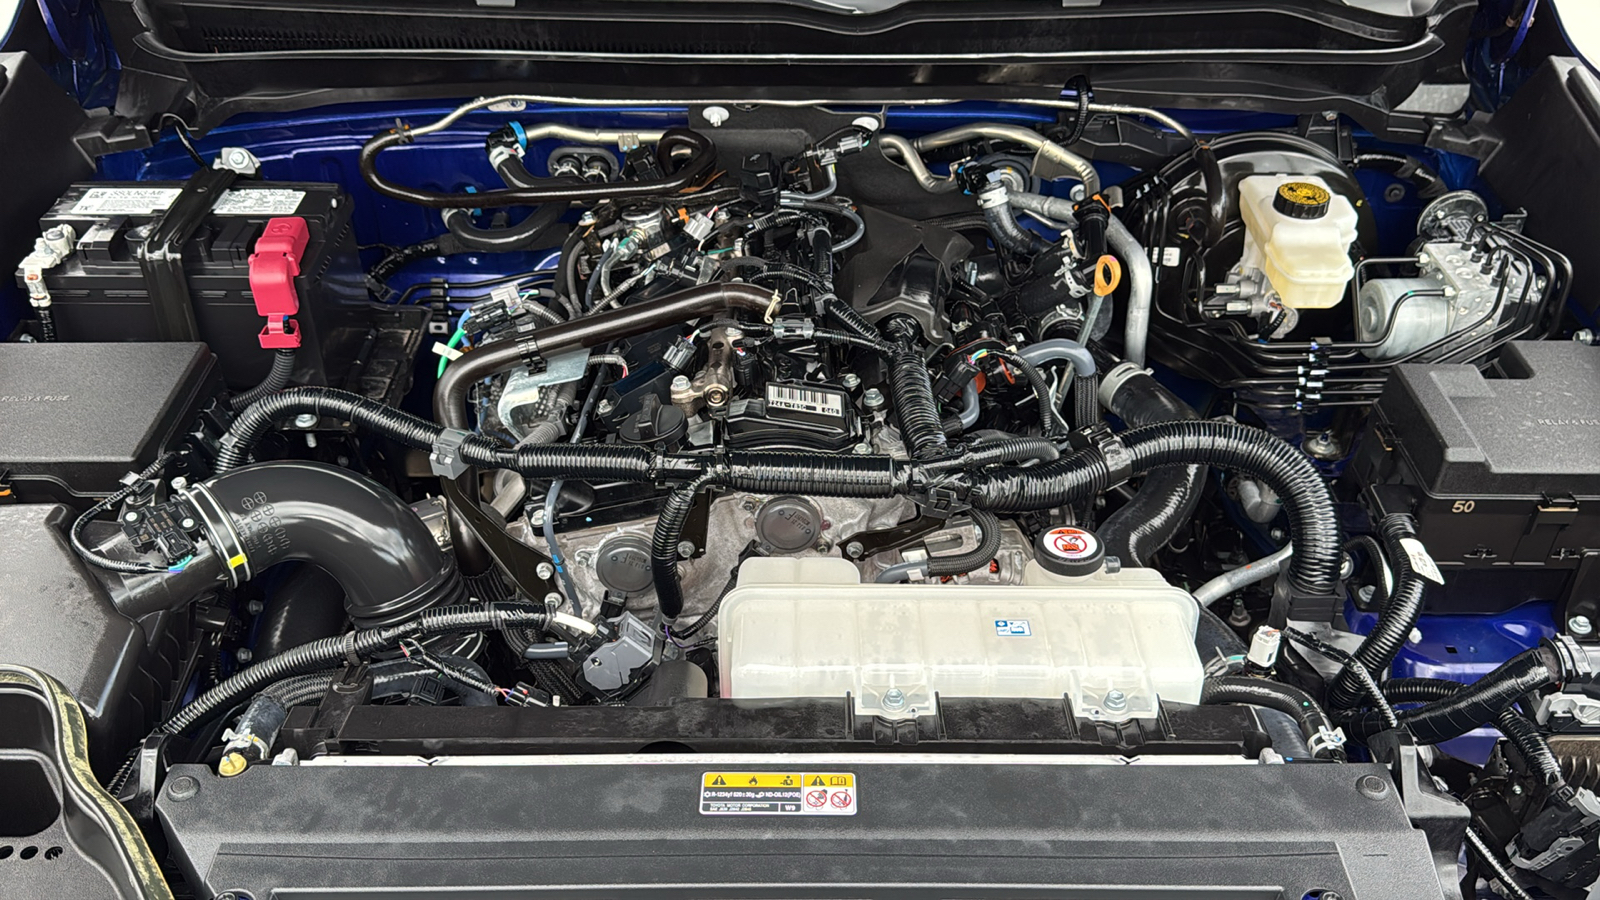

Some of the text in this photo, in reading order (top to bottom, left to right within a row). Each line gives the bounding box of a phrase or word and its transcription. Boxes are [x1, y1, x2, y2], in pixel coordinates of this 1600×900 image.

[43, 394, 70, 402] FUSE
[1537, 417, 1569, 426] RELAY
[1451, 500, 1475, 513] 50
[785, 804, 796, 812] W9
